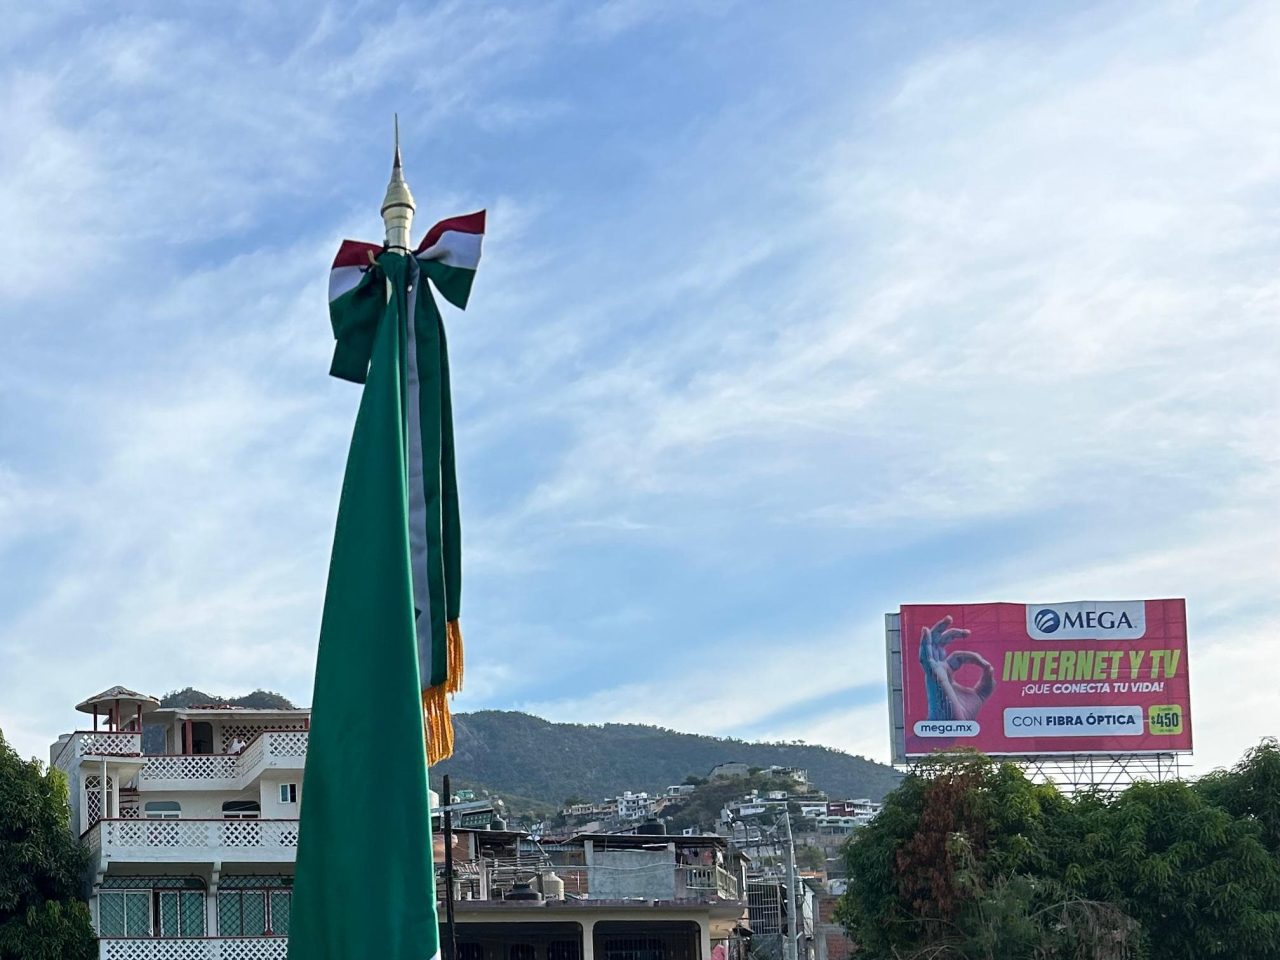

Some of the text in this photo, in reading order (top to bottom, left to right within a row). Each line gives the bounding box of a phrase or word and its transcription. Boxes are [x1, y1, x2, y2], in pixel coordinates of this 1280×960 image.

[1063, 611, 1133, 629] MEGA
[1002, 650, 1181, 682] INTERNET Y TV
[1022, 682, 1164, 696] ¡QUE CONECTA TU VIDA!
[1012, 712, 1135, 727] CON FIBRA ÓPTICA
[1150, 712, 1179, 728] $450
[920, 723, 972, 735] mega.mx
